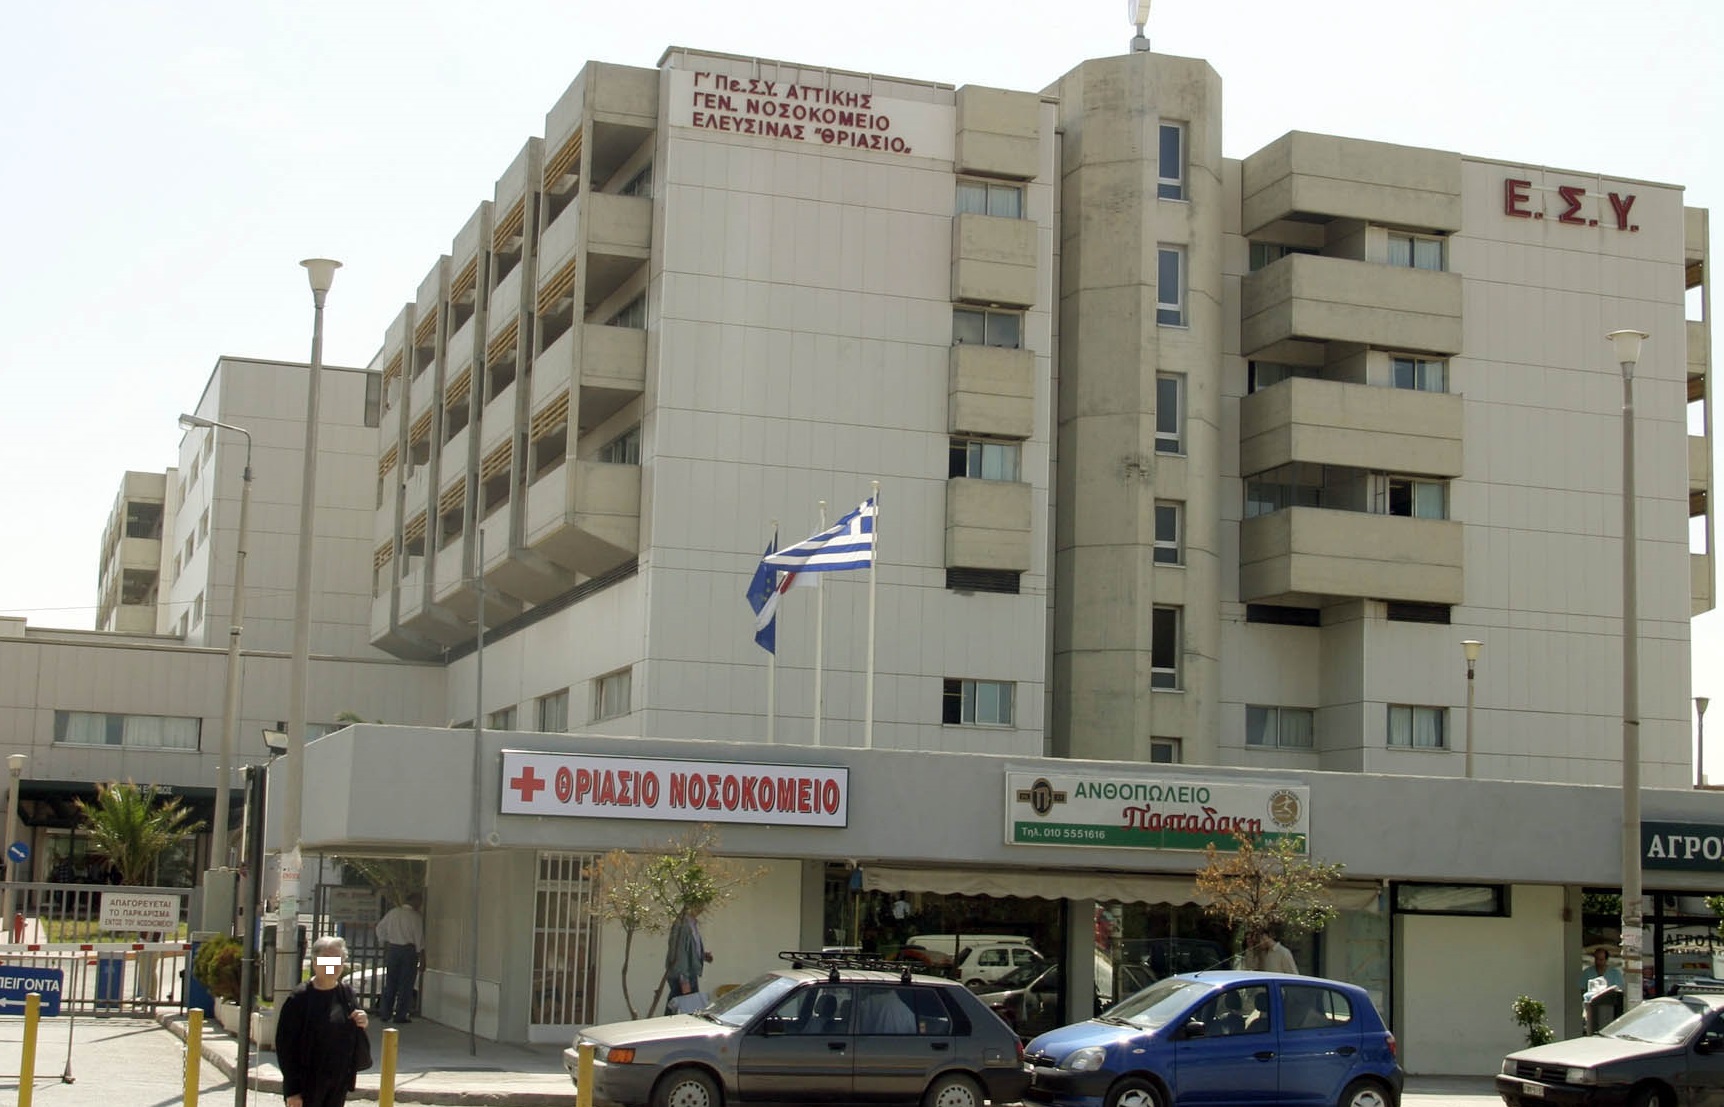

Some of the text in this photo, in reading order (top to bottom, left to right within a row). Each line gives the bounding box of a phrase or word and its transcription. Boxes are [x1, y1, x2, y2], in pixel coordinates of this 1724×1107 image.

[786, 84, 873, 110] ΑΤΤΙΚΗΣ
[693, 91, 890, 131] ΓΕΝ. ΝΟΣΟΚΟΜΕΙΟ
[692, 112, 805, 140] ΕΛΕΥΣΙΝΑΣ
[554, 766, 840, 815] ΘΡΙΑΣΙΟ ΝΟΣΟΚΟΜΕΙΟ
[1075, 782, 1210, 804] ΑΝΘΟΠΩΛΕΙΟ
[1121, 803, 1264, 836] Παπαδακη
[1021, 827, 1106, 839] Τηλ. 010 5551616
[1647, 834, 1724, 860] ΑΓΡΟ
[109, 909, 120, 917] ΤΟ
[110, 899, 172, 908] ΑΠΑΓΟΡΕΥΕΤΑΙ
